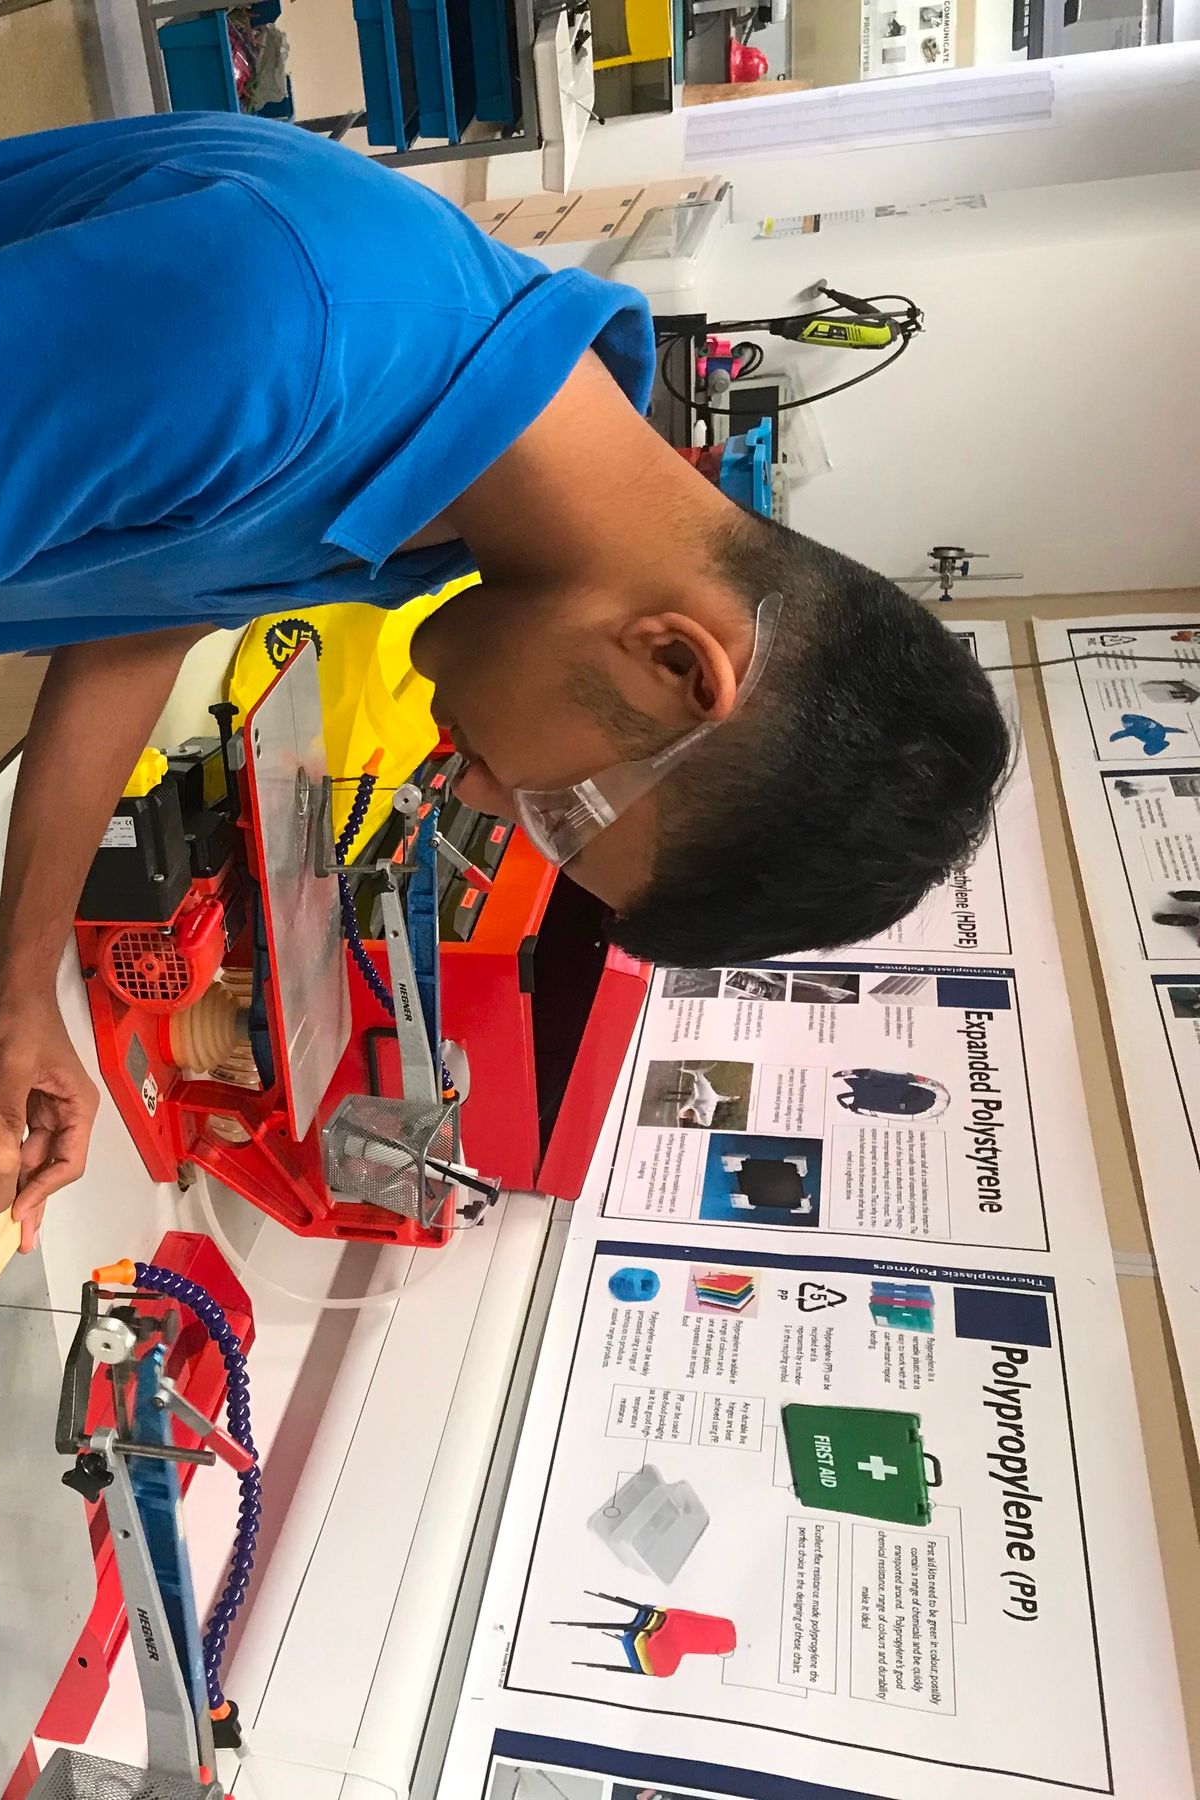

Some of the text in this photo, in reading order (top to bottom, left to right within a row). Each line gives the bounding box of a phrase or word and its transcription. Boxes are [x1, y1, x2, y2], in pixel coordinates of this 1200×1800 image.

[273, 628, 298, 662] 75
[950, 870, 978, 949] ethylene (HDPE)
[928, 968, 1005, 976] Thermoplastic
[399, 983, 412, 1022] HEGNER
[957, 1011, 1004, 1213] Expanded Polystyrene
[873, 1264, 1046, 1287] Thermoplastic Polymers
[778, 1290, 788, 1300] PP
[823, 1328, 833, 1361] Polypropylene
[897, 1334, 905, 1344] easy
[926, 1337, 935, 1371] Polypropylene
[823, 1363, 833, 1373] (PP)
[882, 1367, 891, 1383] repeat
[630, 1396, 642, 1428] temperature
[675, 1402, 683, 1411] can
[741, 1402, 751, 1412] Any
[655, 1415, 668, 1439] packaging
[672, 1421, 681, 1433] used
[740, 1414, 749, 1433] durable
[725, 1430, 734, 1440] best
[814, 1435, 837, 1488] FIRST AID
[983, 1345, 1042, 1622] Polypropylene (PP)
[797, 1527, 807, 1548] perfect
[878, 1531, 886, 1558] chemical
[927, 1541, 936, 1556] First
[797, 1550, 806, 1569] choice
[894, 1545, 904, 1583] transported
[911, 1548, 919, 1571] contain
[928, 1557, 937, 1567] aid
[928, 1568, 937, 1580] kits
[797, 1579, 805, 1590] the
[910, 1578, 919, 1597] range
[928, 1582, 937, 1599] need
[809, 1525, 824, 1682] Excellent flex resistance made polypropylene the
[862, 1587, 870, 1604] make
[876, 1594, 885, 1612] range
[912, 1598, 921, 1606] of
[793, 1591, 804, 1622] designing
[929, 1609, 938, 1617] be
[794, 1623, 804, 1631] of
[878, 1614, 888, 1623] of
[912, 1607, 922, 1639] chemicals
[137, 1608, 159, 1661] HEGNER
[879, 1623, 887, 1648] colours
[927, 1619, 938, 1639] green
[794, 1632, 803, 1649] these
[893, 1616, 905, 1668] Polypropylene's
[913, 1642, 922, 1654] and
[879, 1651, 887, 1664] and
[913, 1656, 922, 1665] be
[876, 1666, 888, 1700] durability
[894, 1670, 905, 1690] good
[911, 1667, 923, 1692] quickly
[929, 1675, 941, 1705] possibly
